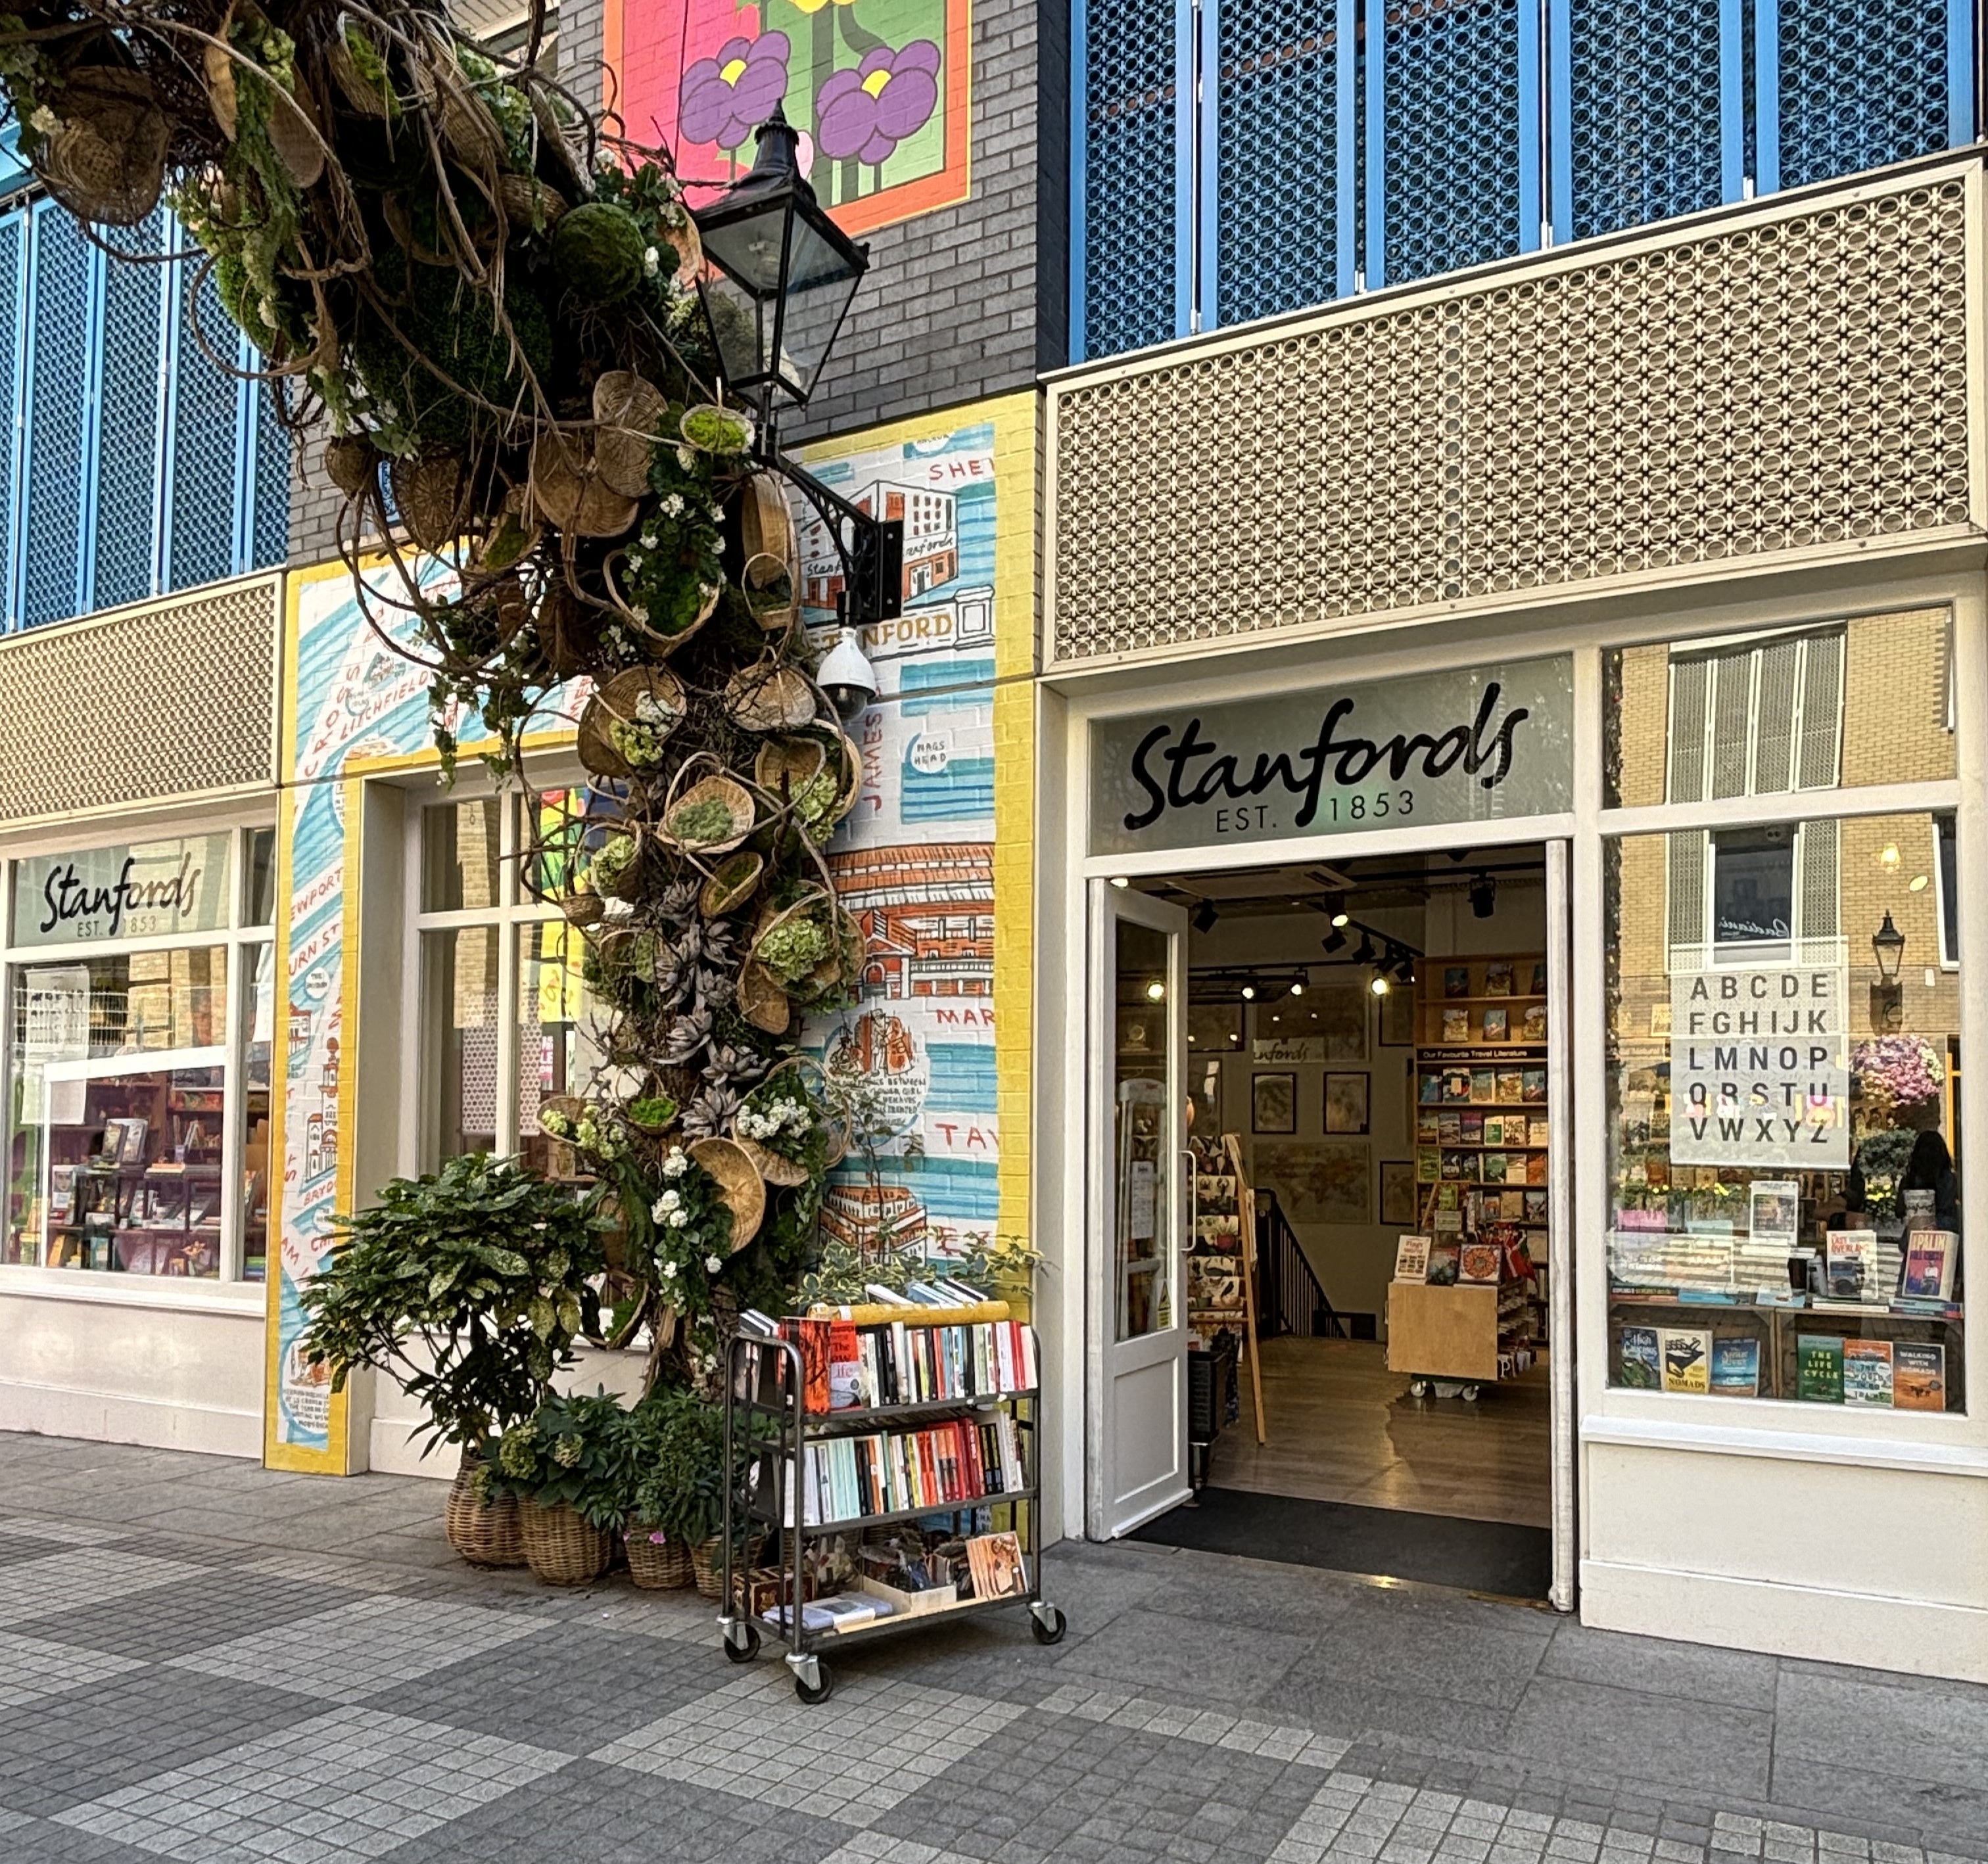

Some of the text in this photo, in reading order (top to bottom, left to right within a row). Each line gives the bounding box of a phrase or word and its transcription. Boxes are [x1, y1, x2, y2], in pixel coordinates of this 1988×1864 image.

[339, 670, 428, 741] LITCHFIELD
[917, 741, 945, 752] NAGS
[861, 712, 882, 812] JAMES
[914, 753, 947, 765] HEAD
[1124, 682, 1528, 831] Stanfords
[1216, 790, 1414, 833] EST. 1853
[40, 852, 201, 936] Stanfords
[77, 920, 104, 938] EST.
[1810, 1350, 1832, 1360] THE
[1808, 1360, 1832, 1370] LIFE
[1803, 1370, 1838, 1380] CYCLE
[1668, 1377, 1706, 1389] NOMADS
